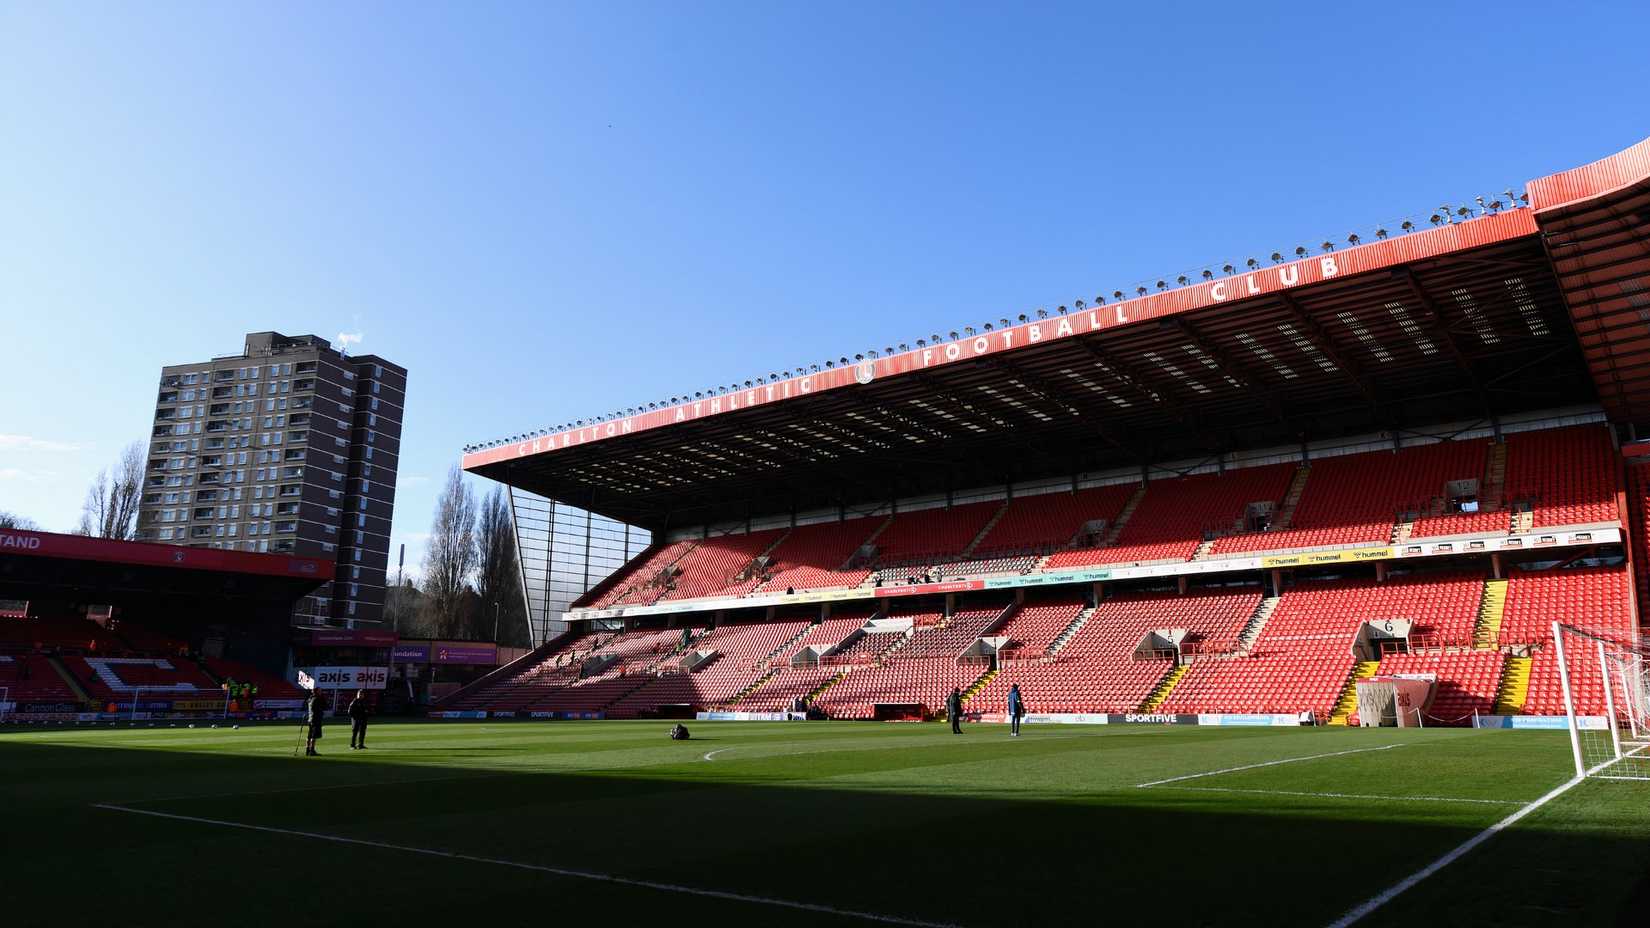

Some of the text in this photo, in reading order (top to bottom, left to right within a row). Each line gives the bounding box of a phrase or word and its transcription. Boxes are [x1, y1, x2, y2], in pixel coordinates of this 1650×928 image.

[519, 257, 1338, 456] CHARLTON ATHLETIC FOOTBALL CLUB
[1362, 550, 1388, 558] hummel
[1385, 621, 1393, 632] 6
[319, 670, 352, 683] axis
[356, 670, 385, 683] axis
[1125, 713, 1177, 723] SPORTFIVE
